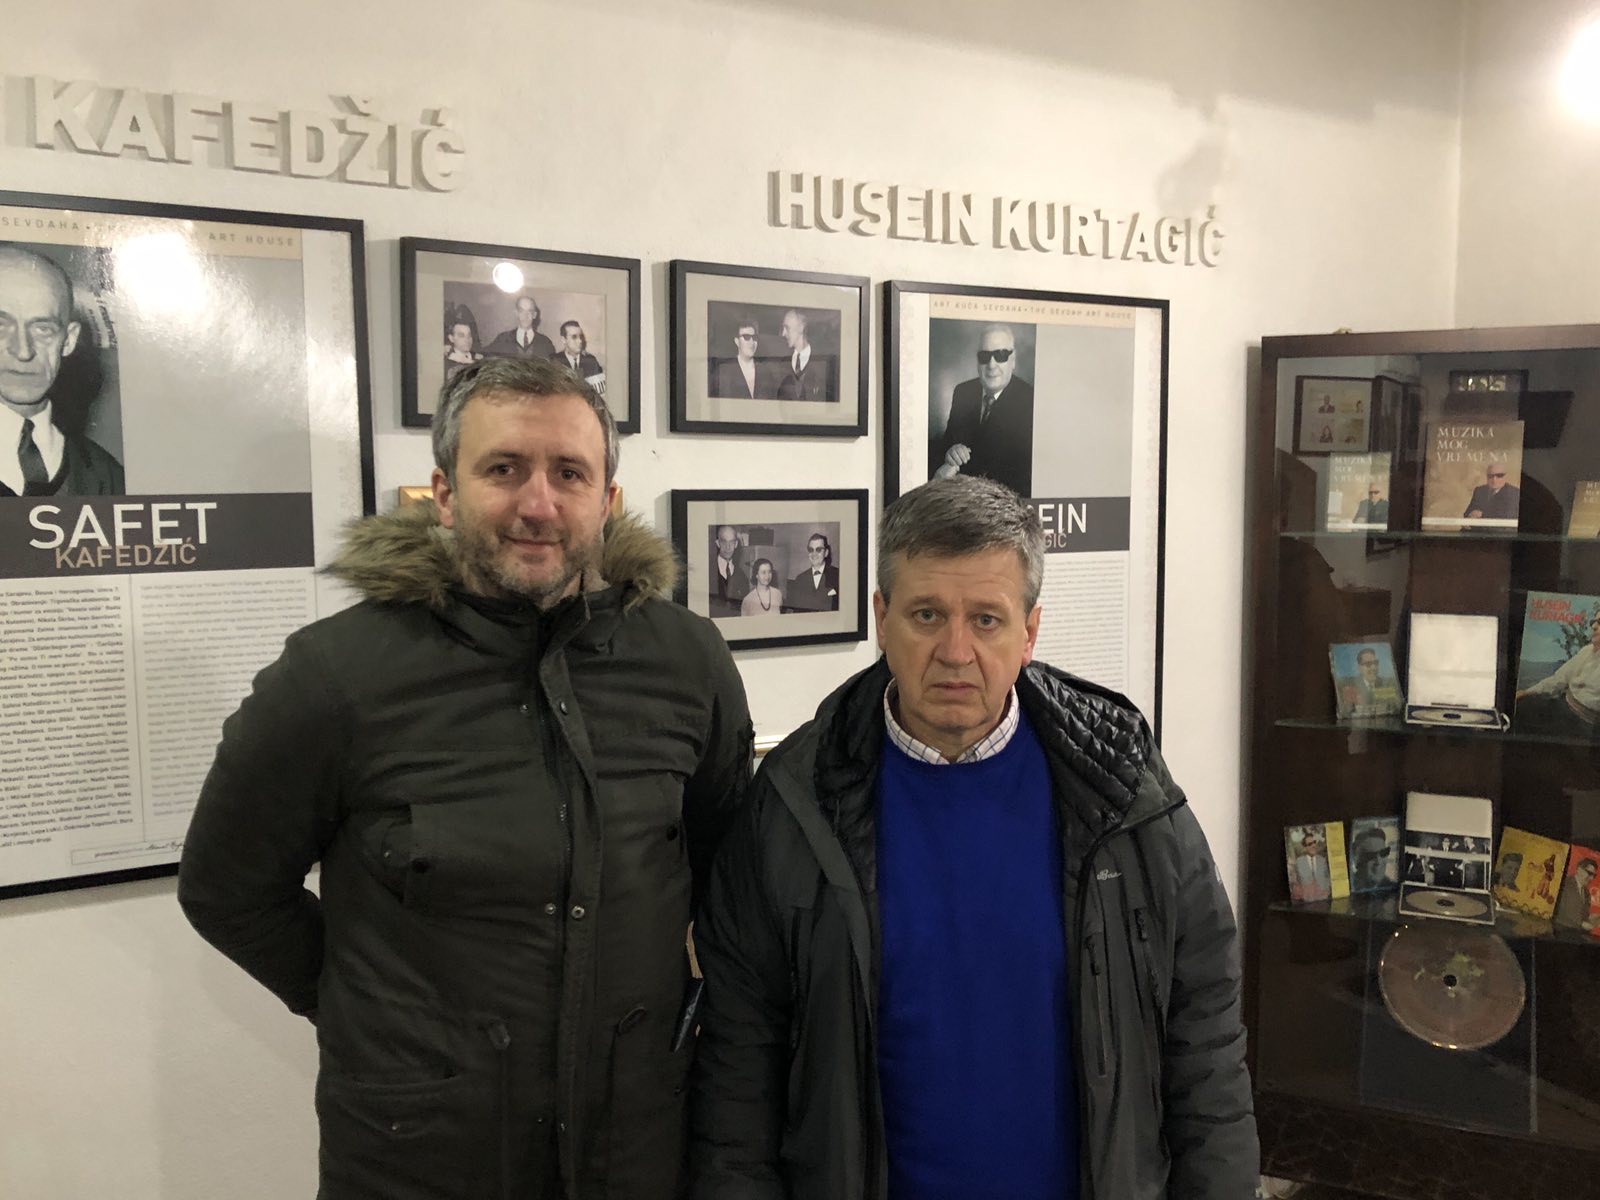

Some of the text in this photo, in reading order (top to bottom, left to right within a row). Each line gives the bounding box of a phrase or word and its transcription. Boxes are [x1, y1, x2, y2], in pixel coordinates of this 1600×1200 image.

[33, 74, 466, 193] KAFEDŽIĆ
[2, 216, 80, 231] SEVDAHA
[208, 232, 236, 242] ART
[245, 235, 293, 247] HOUSE
[768, 170, 1228, 268] HUSEIN KURTAGIĆ
[1437, 426, 1494, 438] MUZIKA
[28, 501, 218, 550] SAFET
